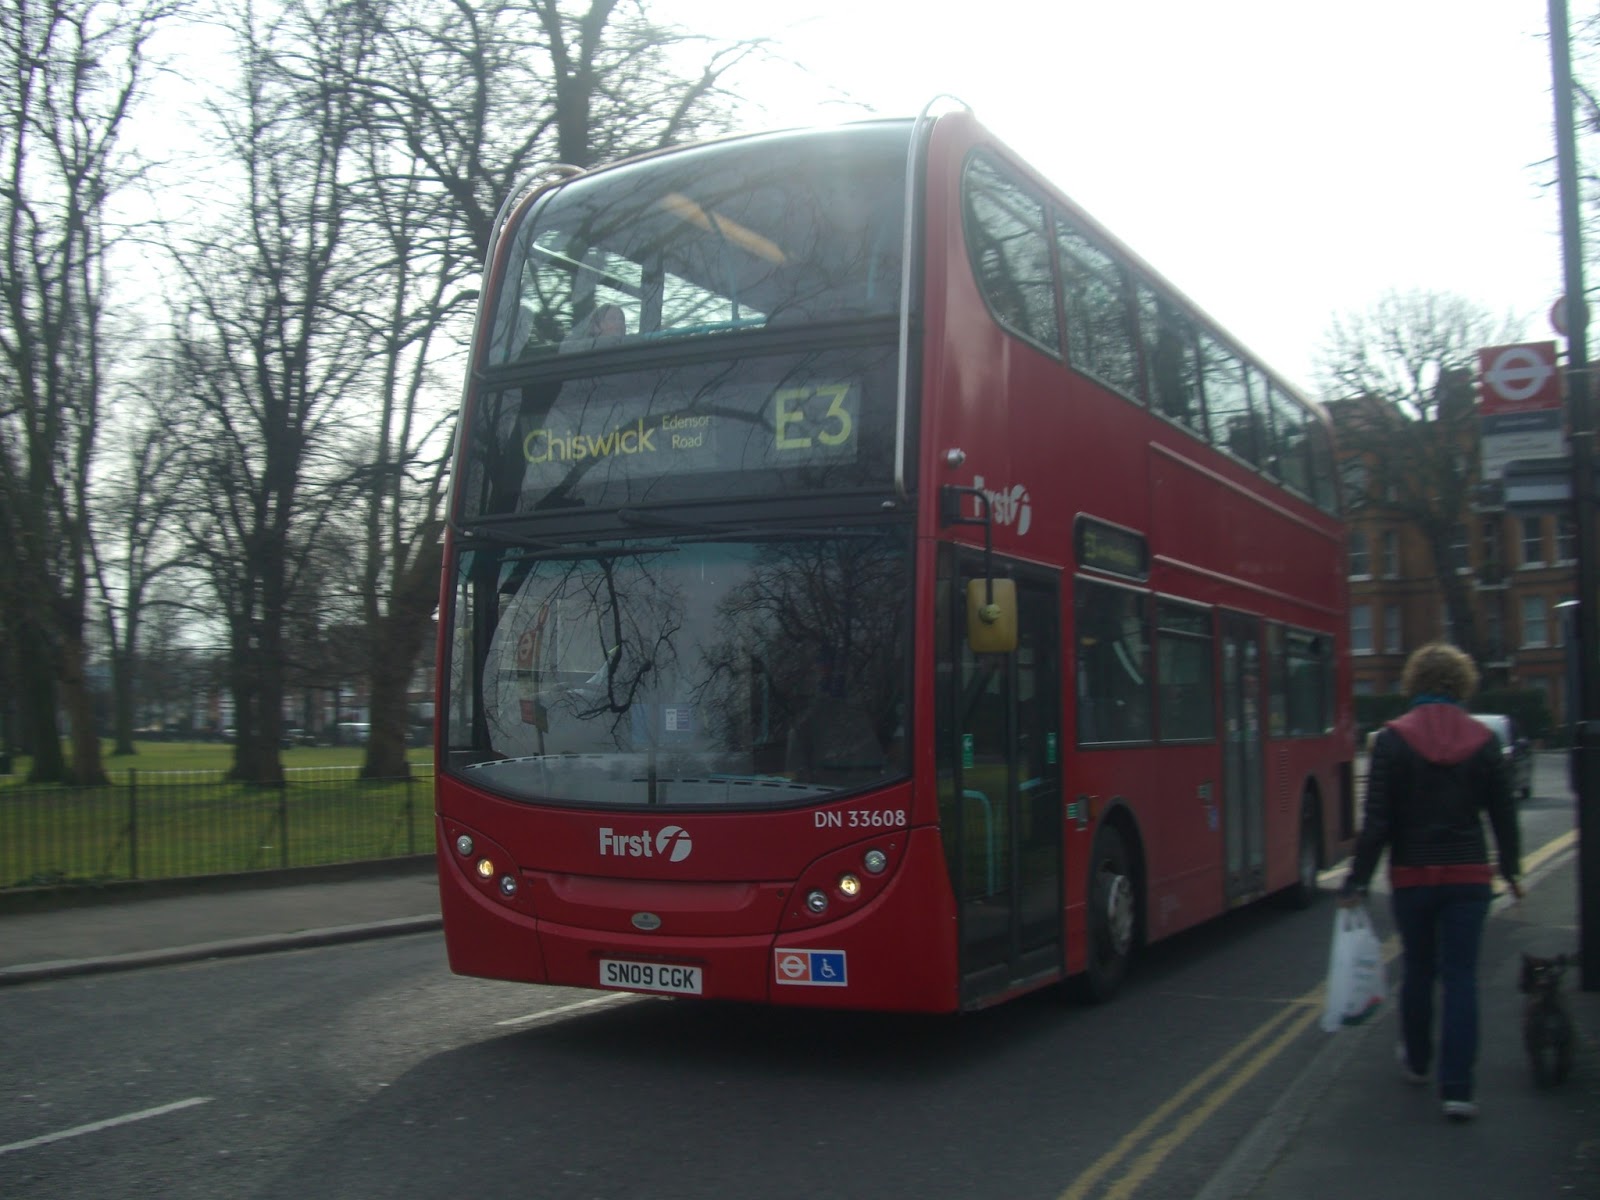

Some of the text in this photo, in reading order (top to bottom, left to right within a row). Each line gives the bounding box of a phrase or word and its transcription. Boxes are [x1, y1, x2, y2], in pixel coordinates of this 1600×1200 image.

[662, 414, 712, 430] Edensor
[775, 383, 853, 451] E3
[523, 419, 656, 464] Chiswick
[671, 432, 703, 449] Road
[814, 810, 907, 828] DN 33608
[599, 827, 652, 857] First
[607, 962, 695, 989] SN09 CGK
